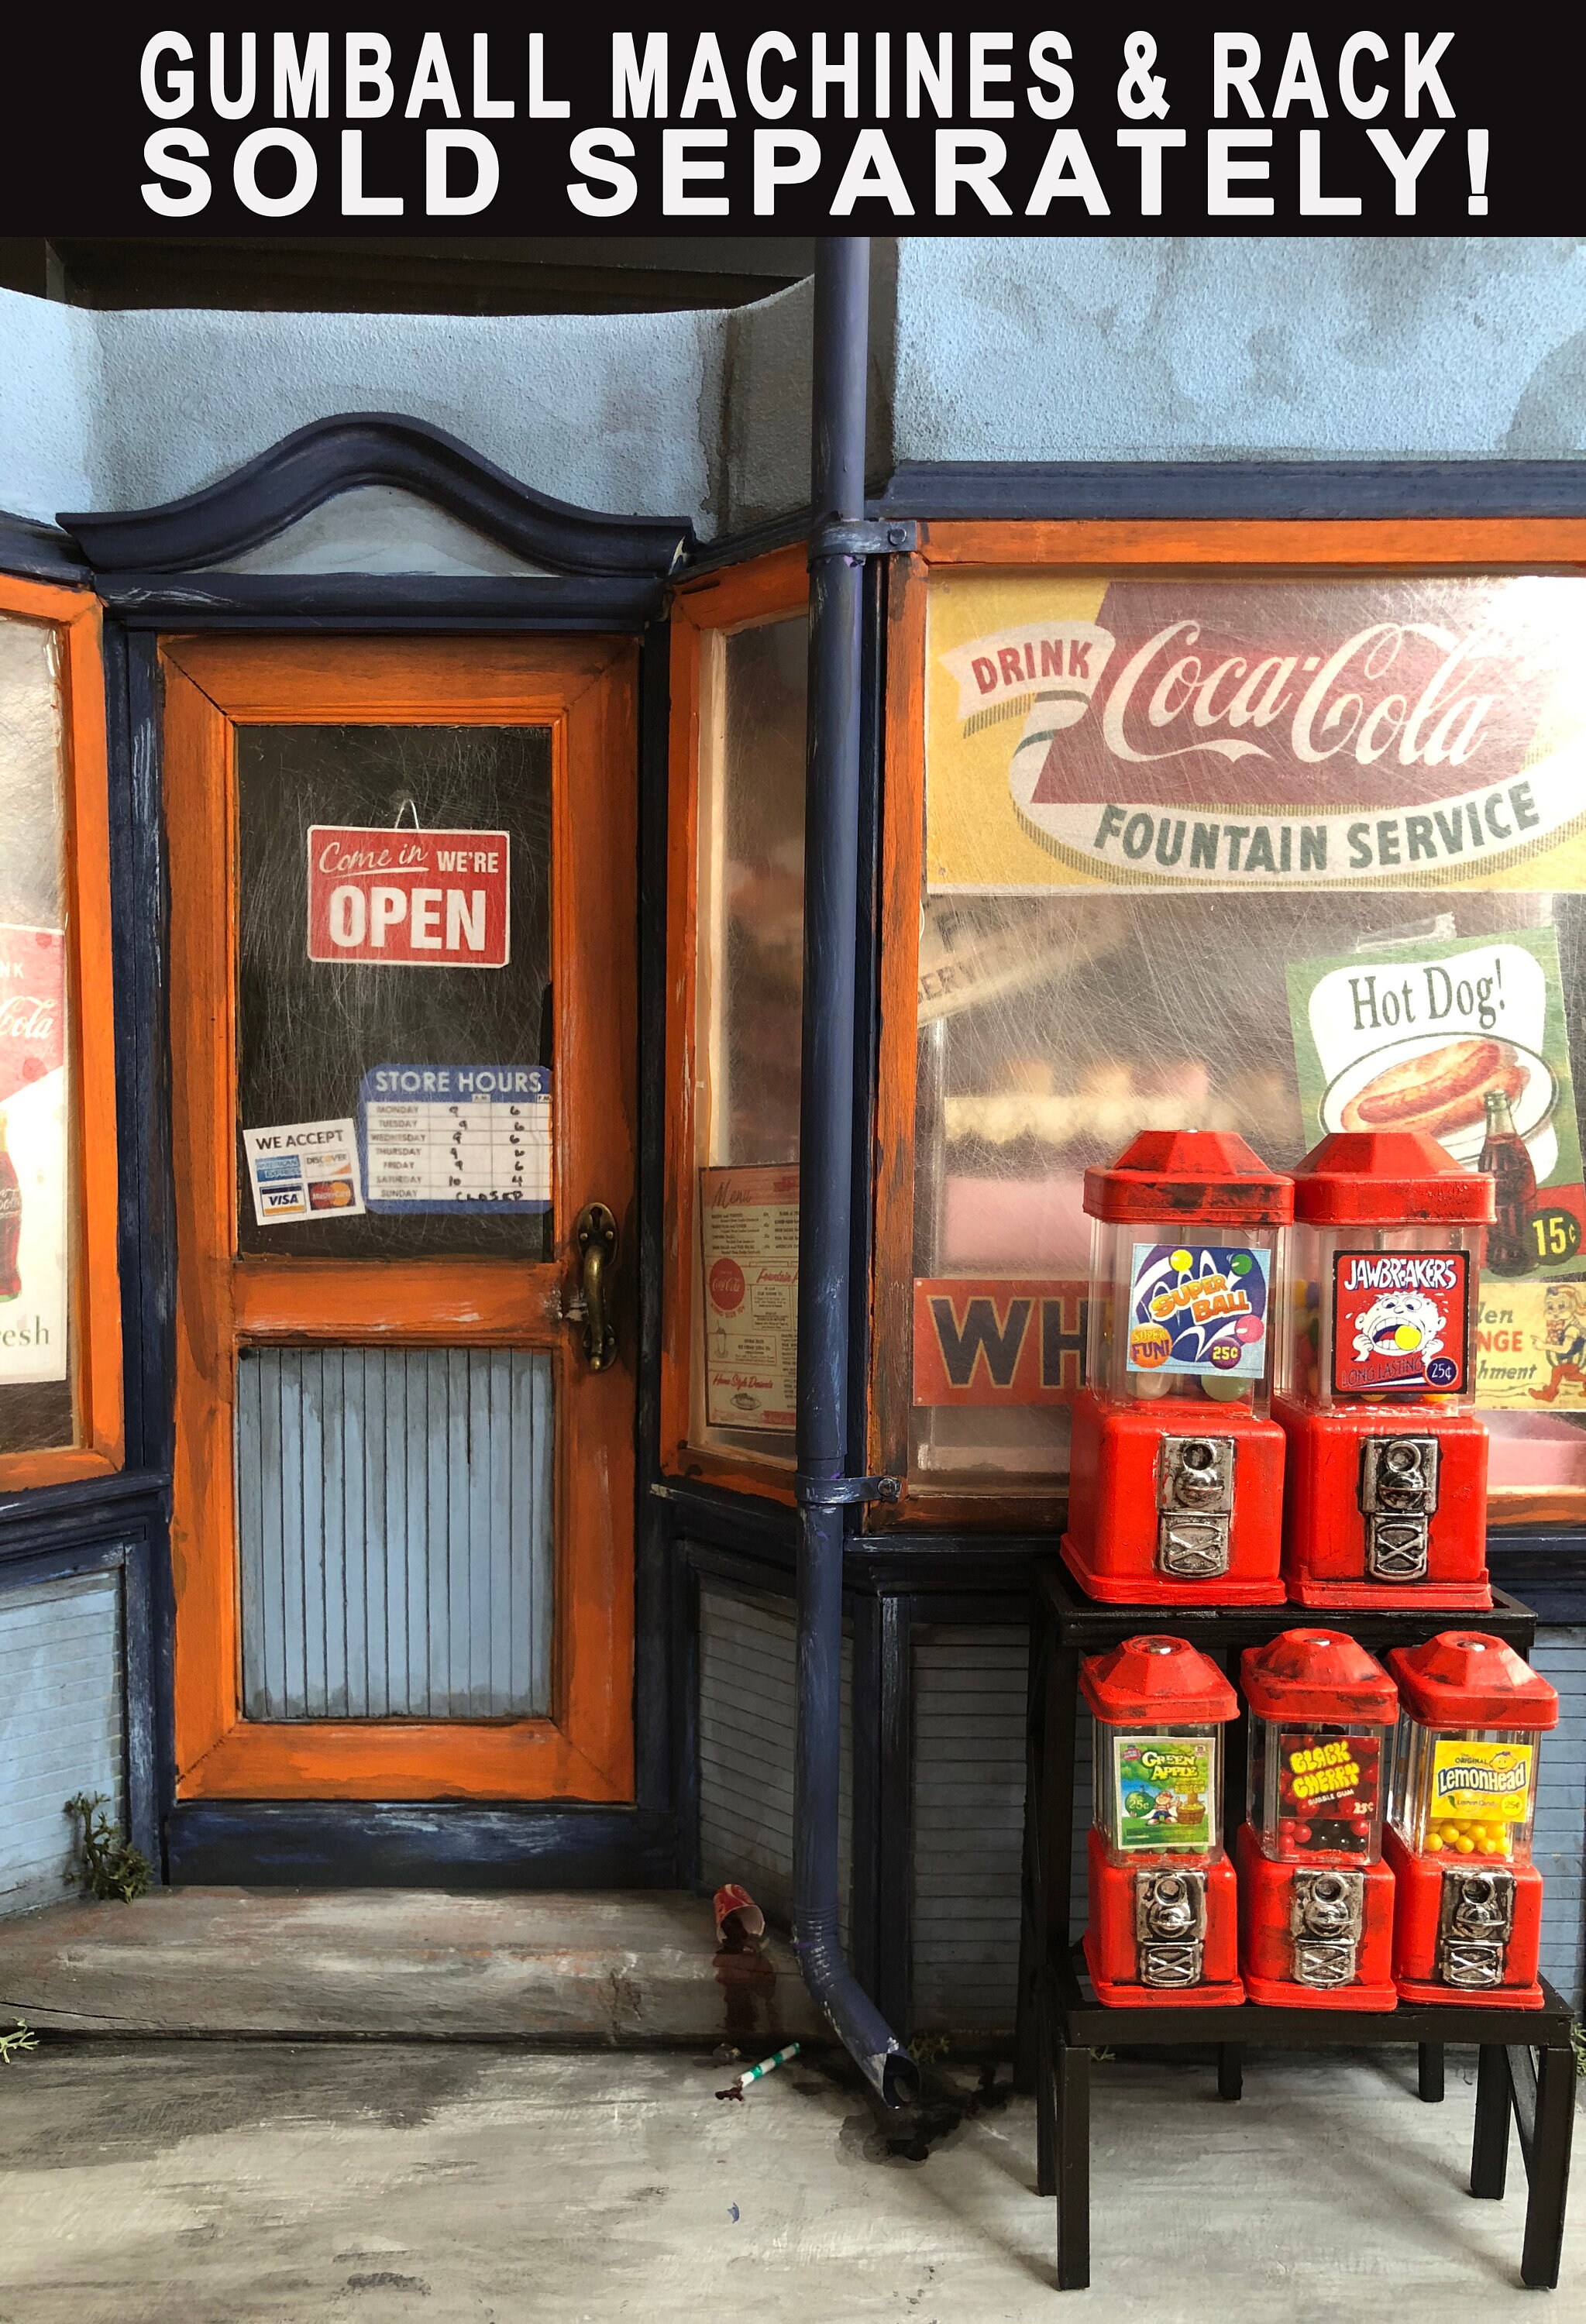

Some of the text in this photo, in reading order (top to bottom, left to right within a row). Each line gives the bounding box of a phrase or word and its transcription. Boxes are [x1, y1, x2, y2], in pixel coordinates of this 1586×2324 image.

[972, 639, 1092, 695] DRINK
[1103, 620, 1495, 766] Coca-Cola
[1094, 781, 1541, 872] FOUNTAIN SERVICE
[318, 842, 498, 873] Come in WE'RE
[329, 885, 486, 951] OPEN
[1348, 958, 1505, 1030] Hot Dog!
[376, 1071, 542, 1092] STORE HOURS
[449, 1106, 459, 1117] 9
[510, 1105, 521, 1116] 6
[459, 1120, 467, 1131] 9
[514, 1122, 525, 1131] 6
[256, 1129, 343, 1150] WE ACCEPT
[306, 1153, 346, 1165] DISCOVER
[449, 1175, 462, 1187] 10
[269, 1194, 298, 1205] VISA
[456, 1191, 524, 1201] CLOSED
[711, 1178, 752, 1210] Menu
[1533, 1217, 1576, 1257] 15¢
[1344, 1258, 1457, 1291] JAWBREAKERS
[1151, 1274, 1227, 1318] SUPER
[1192, 1291, 1249, 1322] BALL
[0, 1315, 50, 1347] esh
[1133, 1329, 1167, 1341] SUPER
[1131, 1339, 1170, 1362] FUN!
[1342, 1356, 1424, 1388] LONG LASTING
[1432, 1363, 1453, 1380] 25¢
[1142, 1752, 1196, 1767] GREEN
[1290, 1740, 1351, 1774] BLACK
[1151, 1765, 1198, 1780] APPLE
[1293, 1762, 1360, 1798] CHERRY
[1308, 1788, 1354, 1806] BUBBLE GUM
